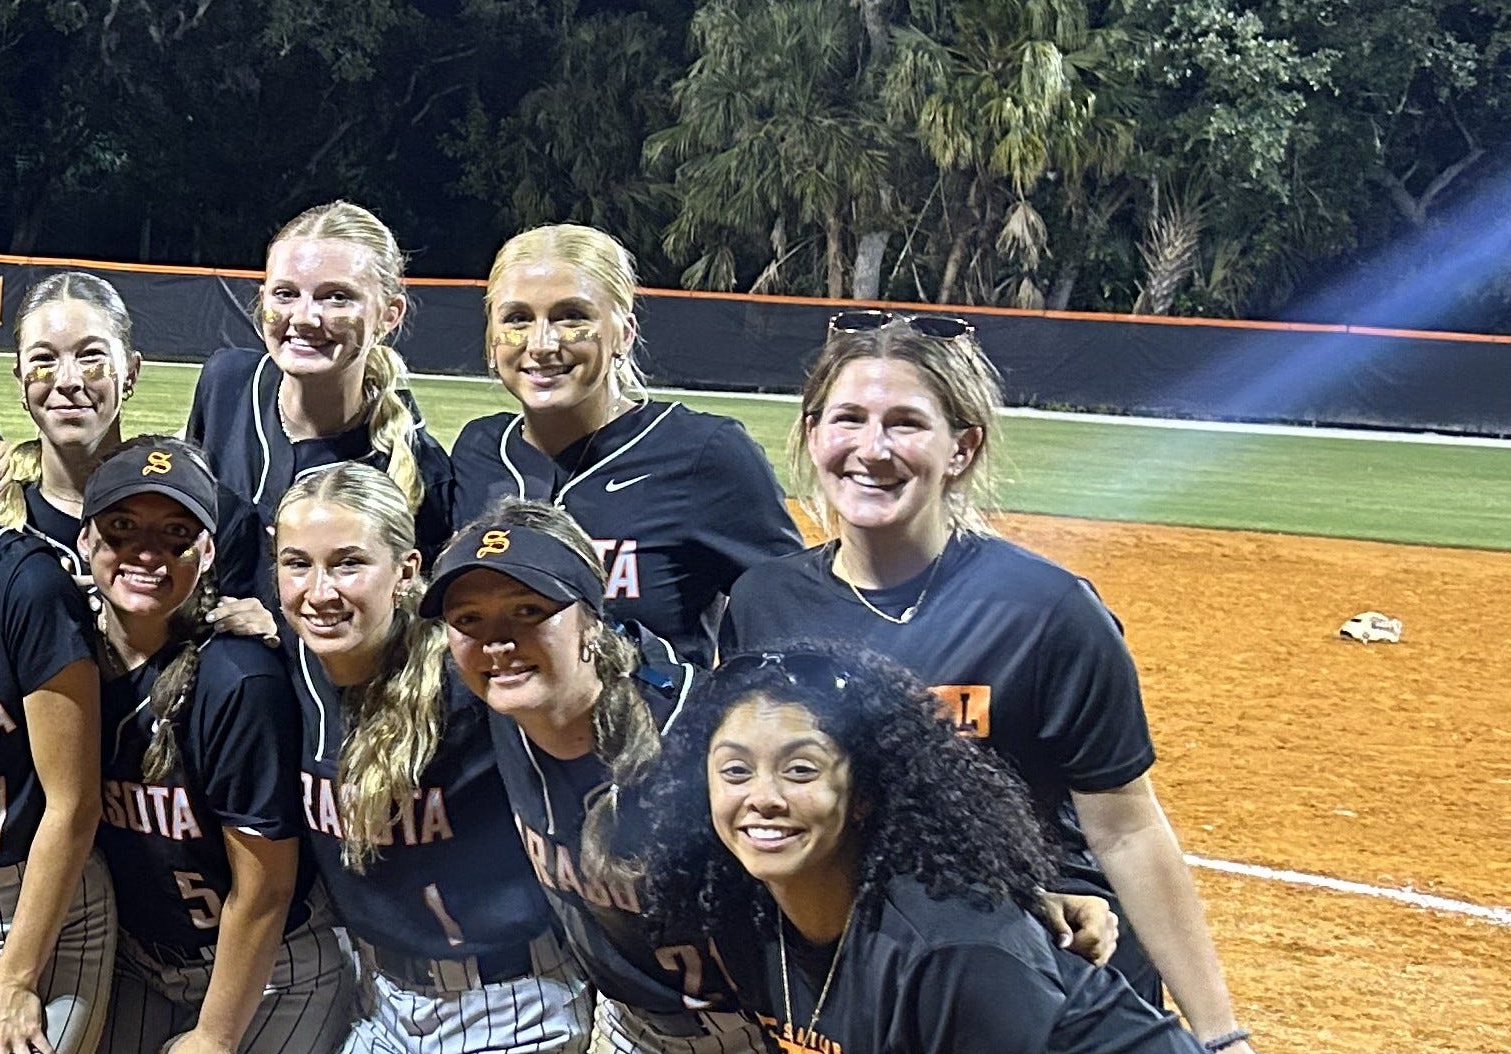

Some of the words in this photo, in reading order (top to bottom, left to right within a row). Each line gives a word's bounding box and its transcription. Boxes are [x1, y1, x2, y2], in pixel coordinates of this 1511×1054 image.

[142, 451, 173, 476] S
[476, 529, 511, 559] S
[173, 869, 222, 930] 5
